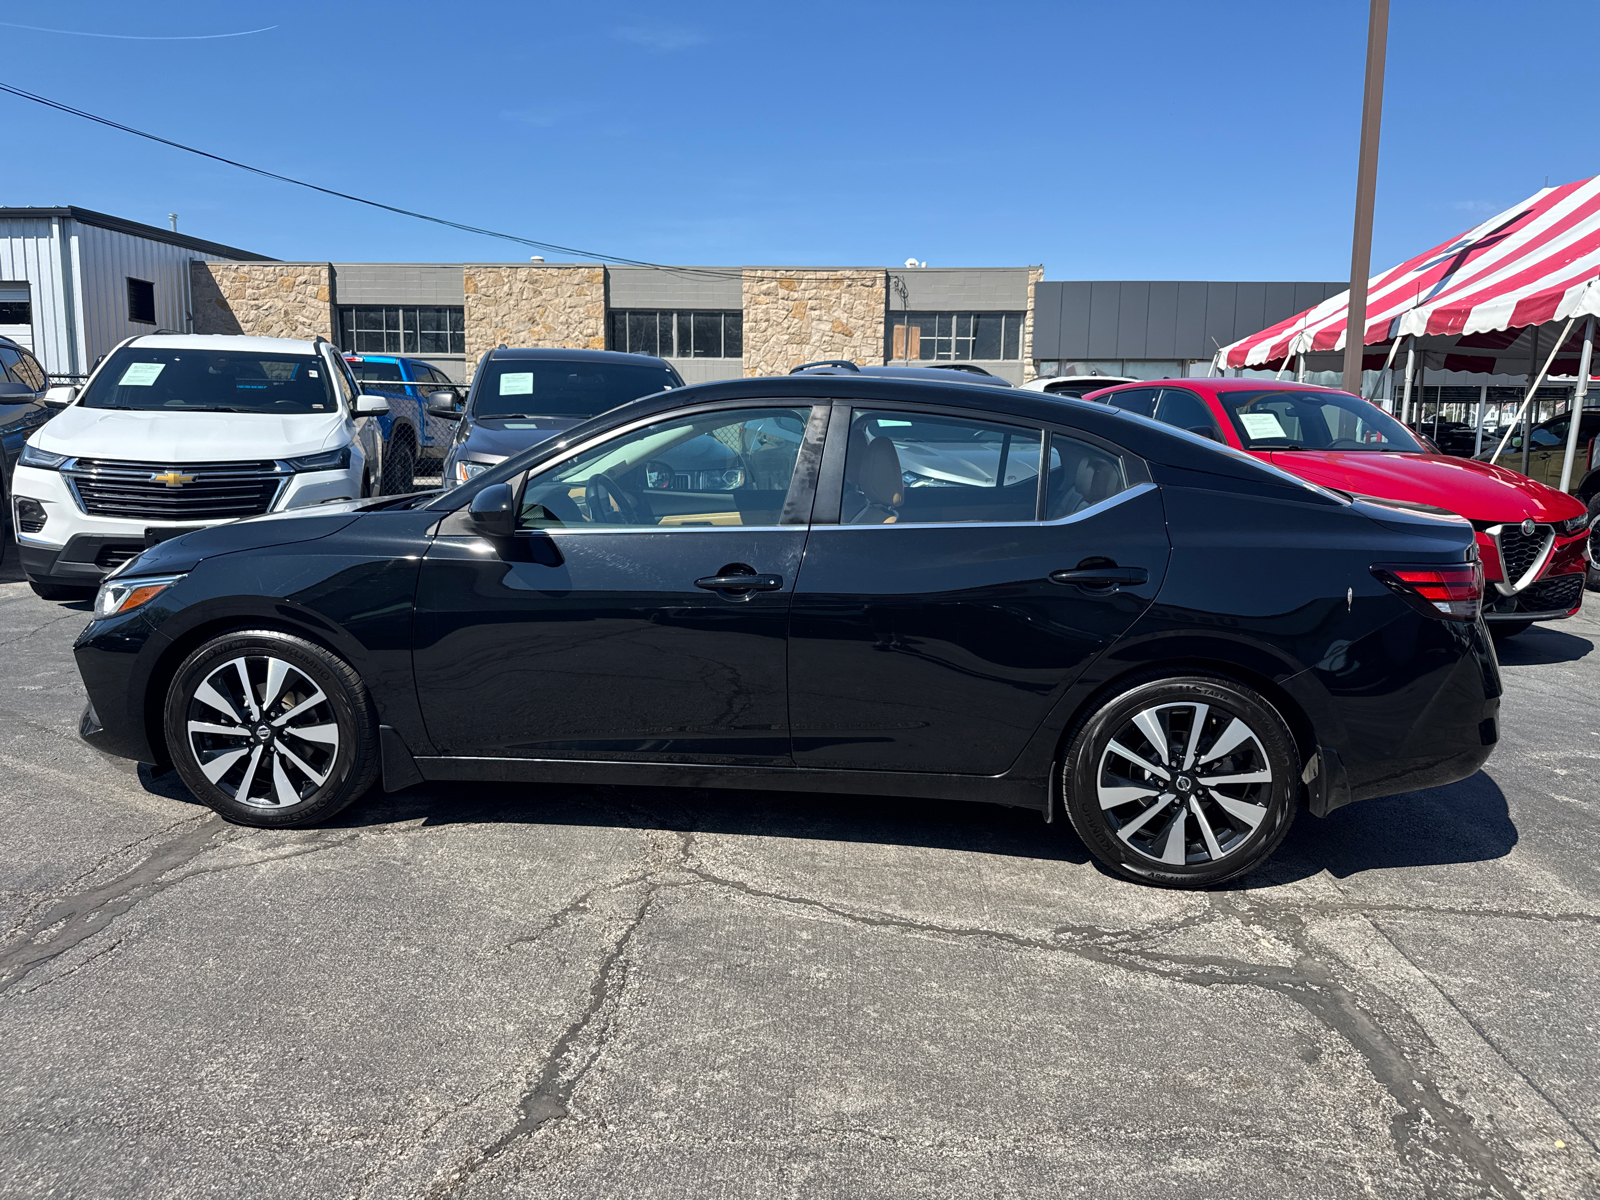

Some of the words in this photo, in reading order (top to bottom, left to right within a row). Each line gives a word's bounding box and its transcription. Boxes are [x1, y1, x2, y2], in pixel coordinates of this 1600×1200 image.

[286, 646, 331, 682] KUMHO
[291, 790, 335, 821] SOLUS
[1082, 802, 1114, 852] KUMHO
